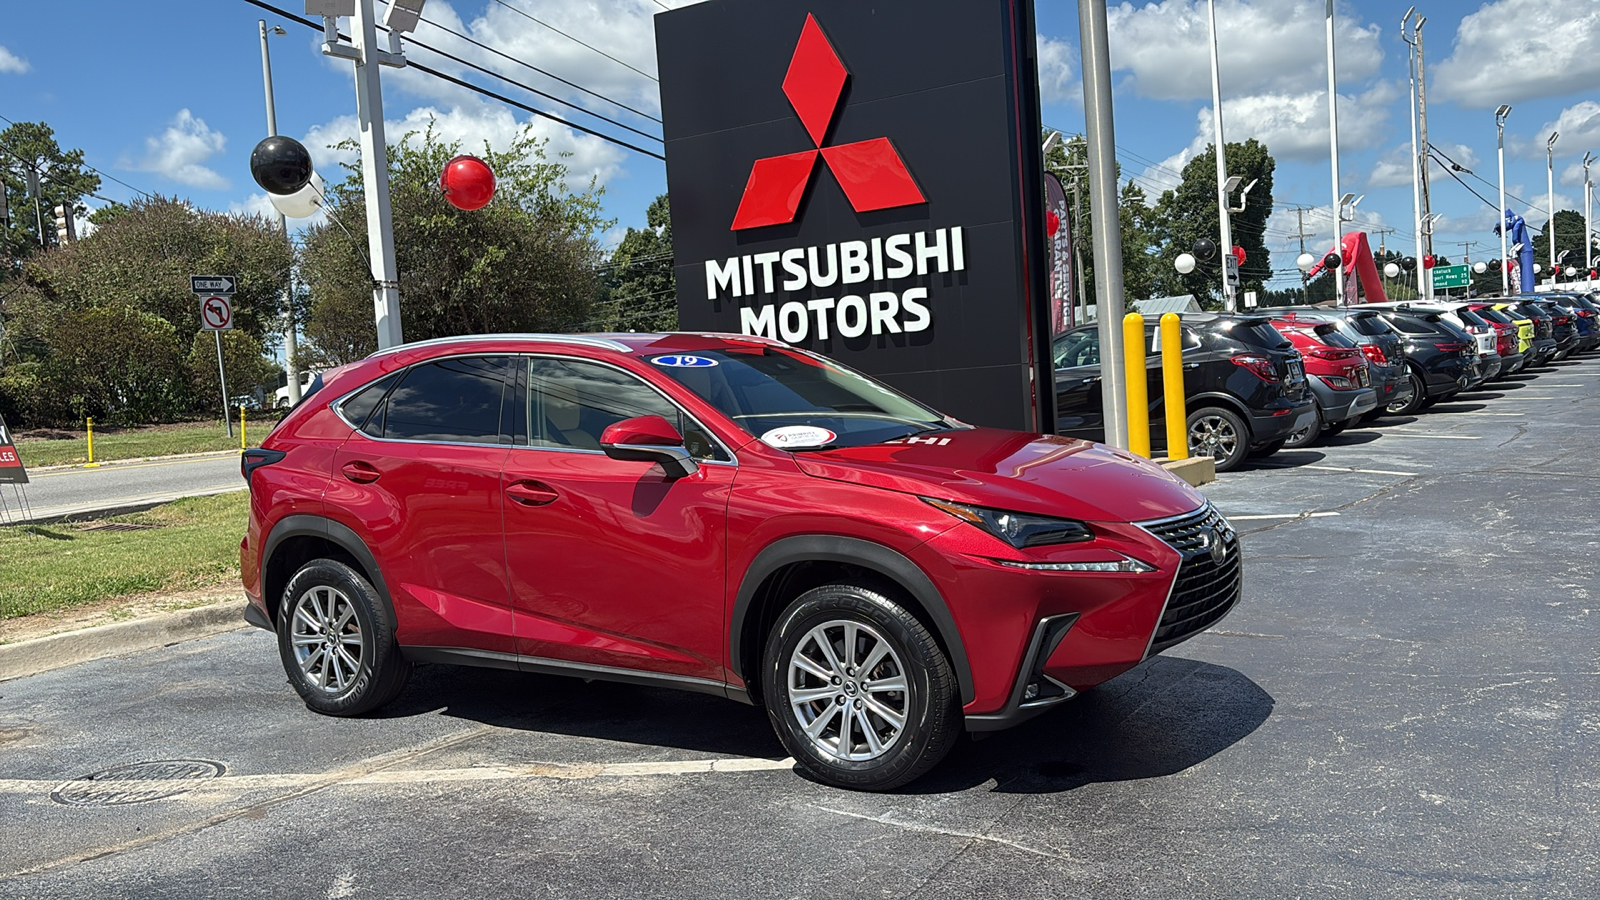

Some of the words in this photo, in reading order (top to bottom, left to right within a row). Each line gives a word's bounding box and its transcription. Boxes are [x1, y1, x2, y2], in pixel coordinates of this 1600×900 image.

[1059, 200, 1068, 248] PARTS
[706, 226, 964, 299] MITSUBISHI
[1053, 208, 1063, 300] GARANTEE
[1061, 250, 1069, 261] &
[1226, 258, 1237, 269] EXIT
[740, 287, 931, 344] MOTORS
[1062, 264, 1071, 326] SERVICE
[674, 356, 698, 366] 19
